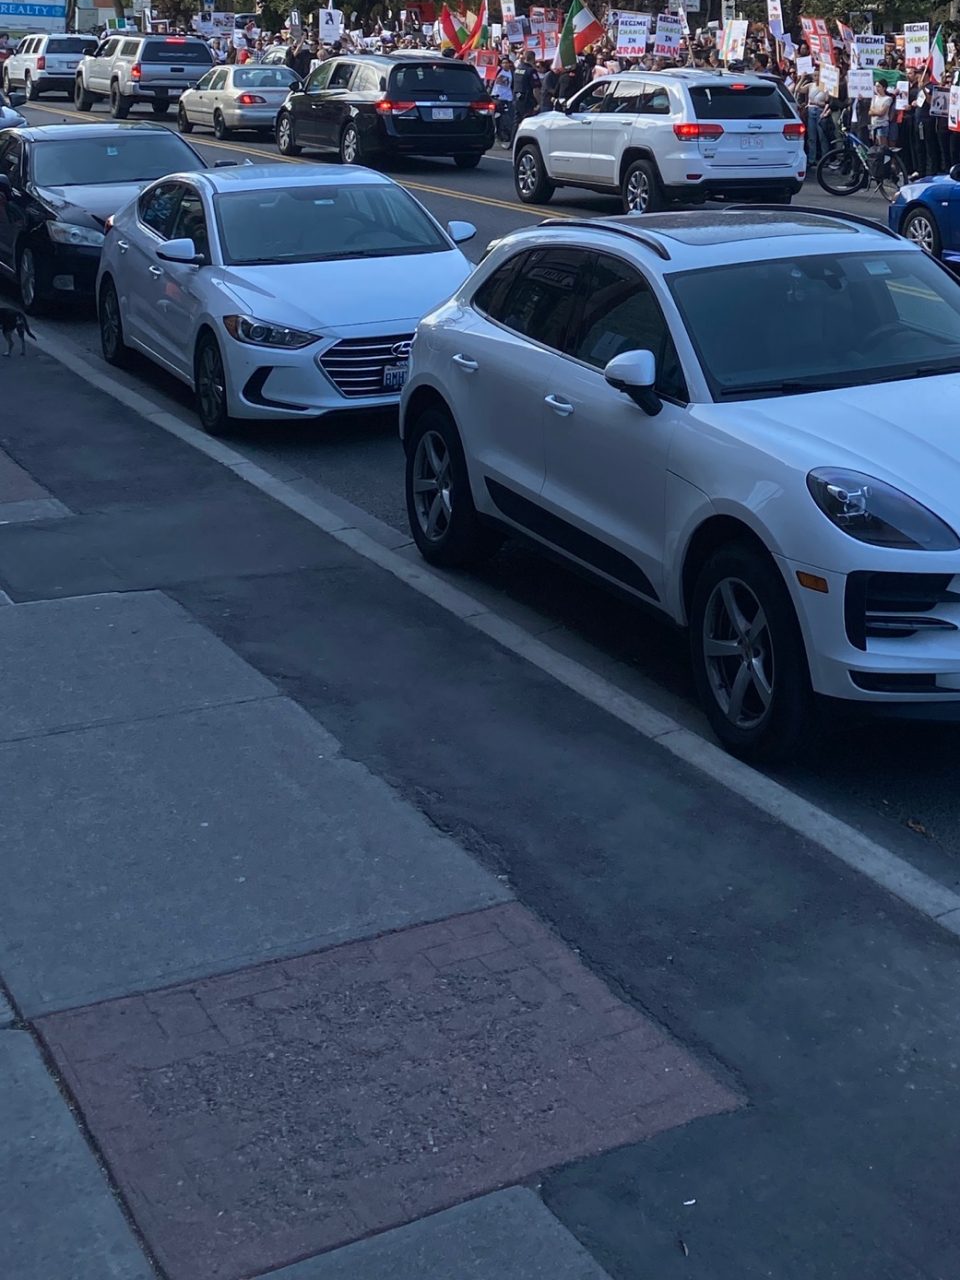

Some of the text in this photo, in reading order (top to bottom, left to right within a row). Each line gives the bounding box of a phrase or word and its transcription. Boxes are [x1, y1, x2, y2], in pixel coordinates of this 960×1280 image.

[1, 4, 49, 15] REALTY
[905, 24, 928, 32] REGIME
[857, 36, 884, 44] REGIME
[617, 46, 644, 55] IRAN
[656, 44, 679, 56] IRAN
